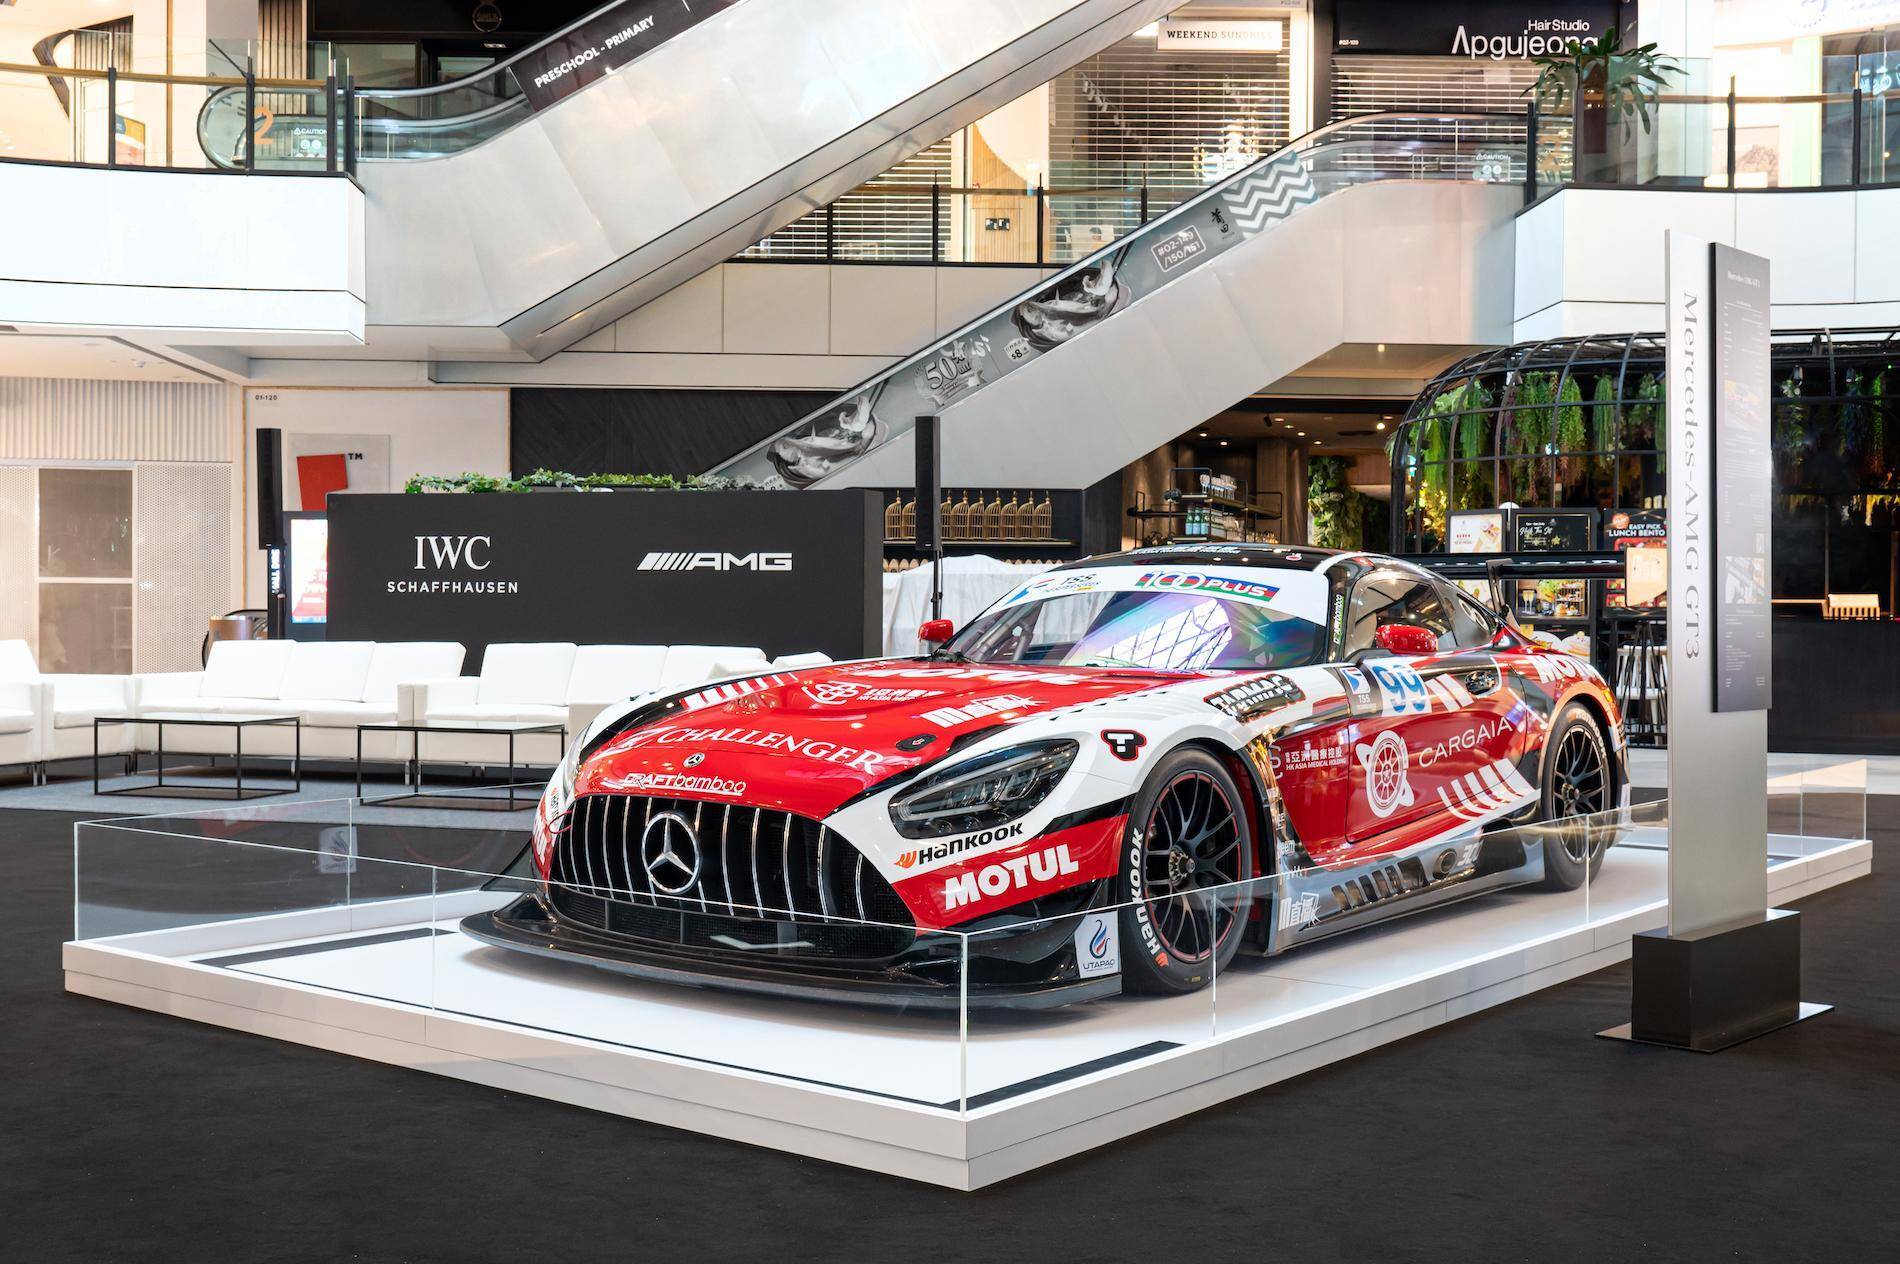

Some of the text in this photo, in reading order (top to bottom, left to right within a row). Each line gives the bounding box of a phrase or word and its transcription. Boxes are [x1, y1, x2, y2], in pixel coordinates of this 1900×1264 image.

[533, 47, 600, 88] PRESCHOOL
[605, 15, 655, 50] PRIMARY
[1167, 30, 1218, 39] WEEKEND
[253, 105, 273, 145] 2
[347, 452, 363, 460] TM
[1684, 292, 1700, 660] Mercedes-AMG GT3
[413, 535, 492, 570] IWC
[1608, 529, 1666, 537] LUNCH BENTO
[387, 580, 519, 594] SCHAFFHAUSEN
[1372, 665, 1426, 713] 99
[656, 727, 887, 776] CHALLENGER
[1418, 716, 1513, 768] CARGAIA
[1286, 763, 1295, 771] HK
[1295, 762, 1308, 770] ASIA
[1308, 760, 1329, 769] MEDICAL
[945, 844, 1080, 911] MOTUL
